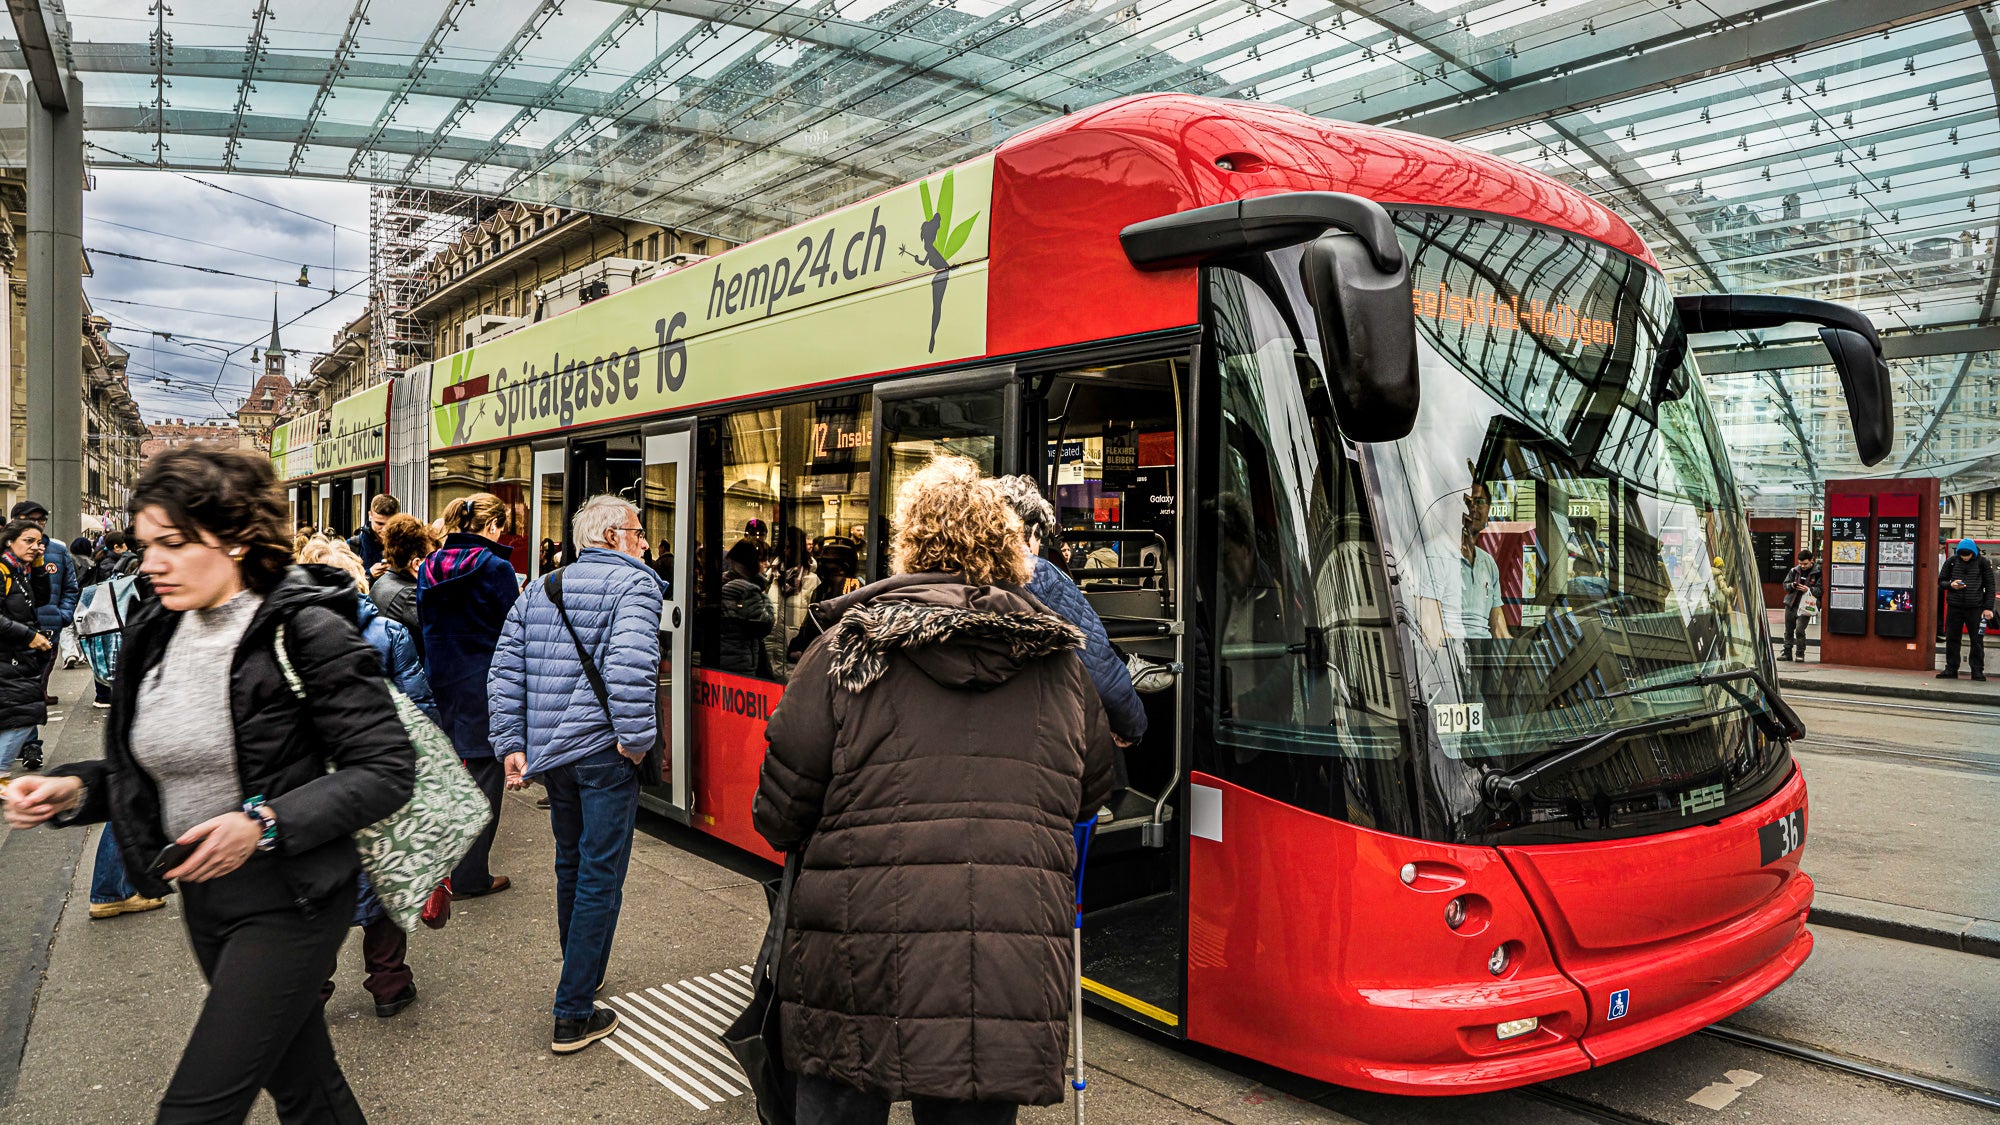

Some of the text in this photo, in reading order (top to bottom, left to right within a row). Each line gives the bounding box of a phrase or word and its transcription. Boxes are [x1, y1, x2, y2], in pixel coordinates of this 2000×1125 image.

[706, 205, 887, 317] hemp24.ch
[494, 311, 688, 437] Spitalgasse 16
[1105, 446, 1136, 455] FLEXIBEL
[1107, 455, 1135, 464] BLEIBEN
[1149, 494, 1175, 505] Galaxy
[1437, 710, 1480, 727] 12 0 8
[1680, 783, 1726, 817] HESS
[1778, 811, 1799, 858] 36
